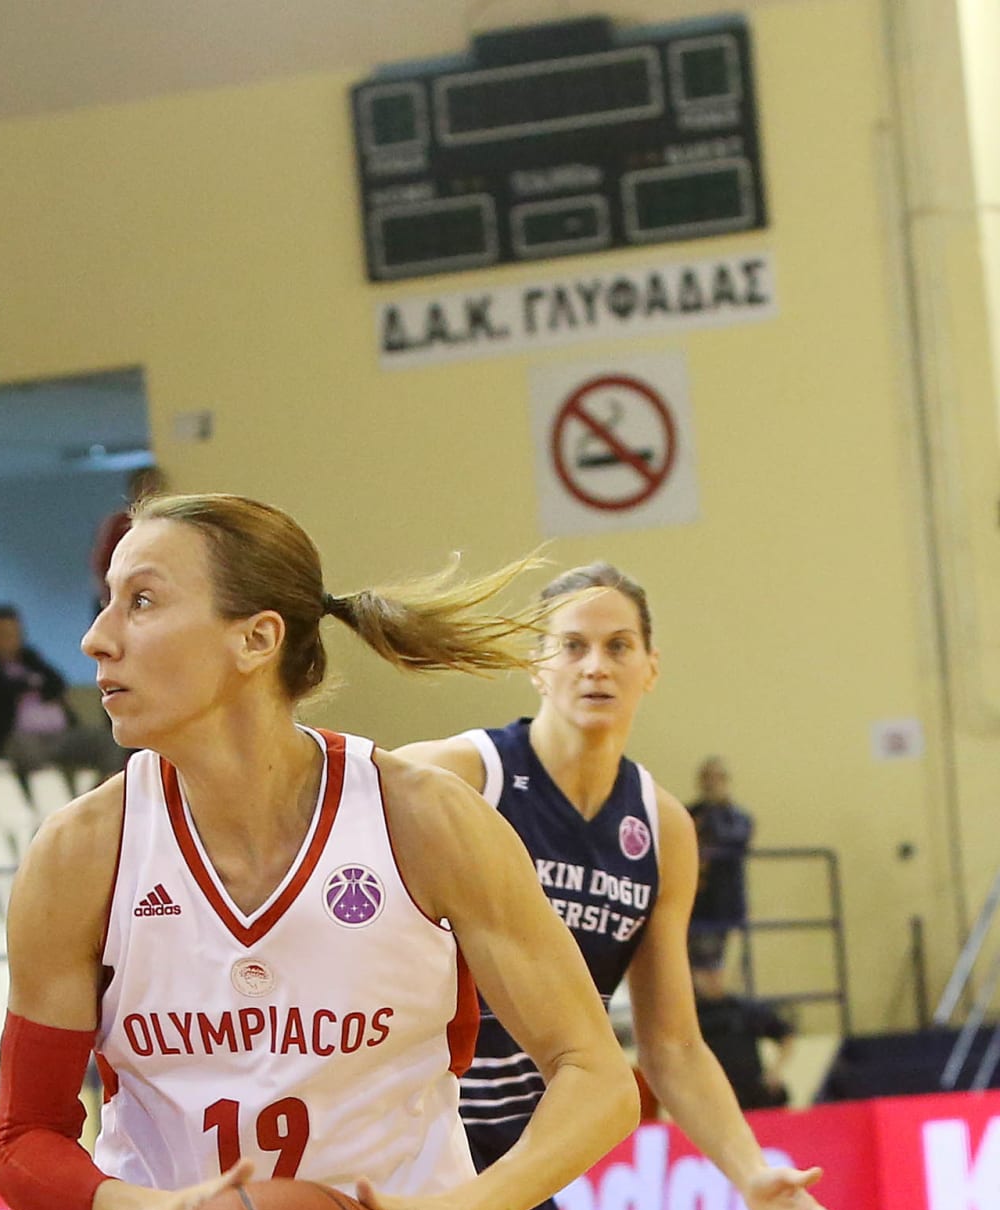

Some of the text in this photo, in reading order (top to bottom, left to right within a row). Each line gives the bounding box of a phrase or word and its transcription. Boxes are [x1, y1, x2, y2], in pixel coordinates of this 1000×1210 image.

[522, 260, 769, 334] ΓΛΥΦΑΔΑΣ
[133, 902, 182, 917] adidas
[535, 858, 651, 910] KIN DOĞU
[122, 1005, 394, 1057] OLYMPIACOS
[202, 1096, 310, 1180] 19
